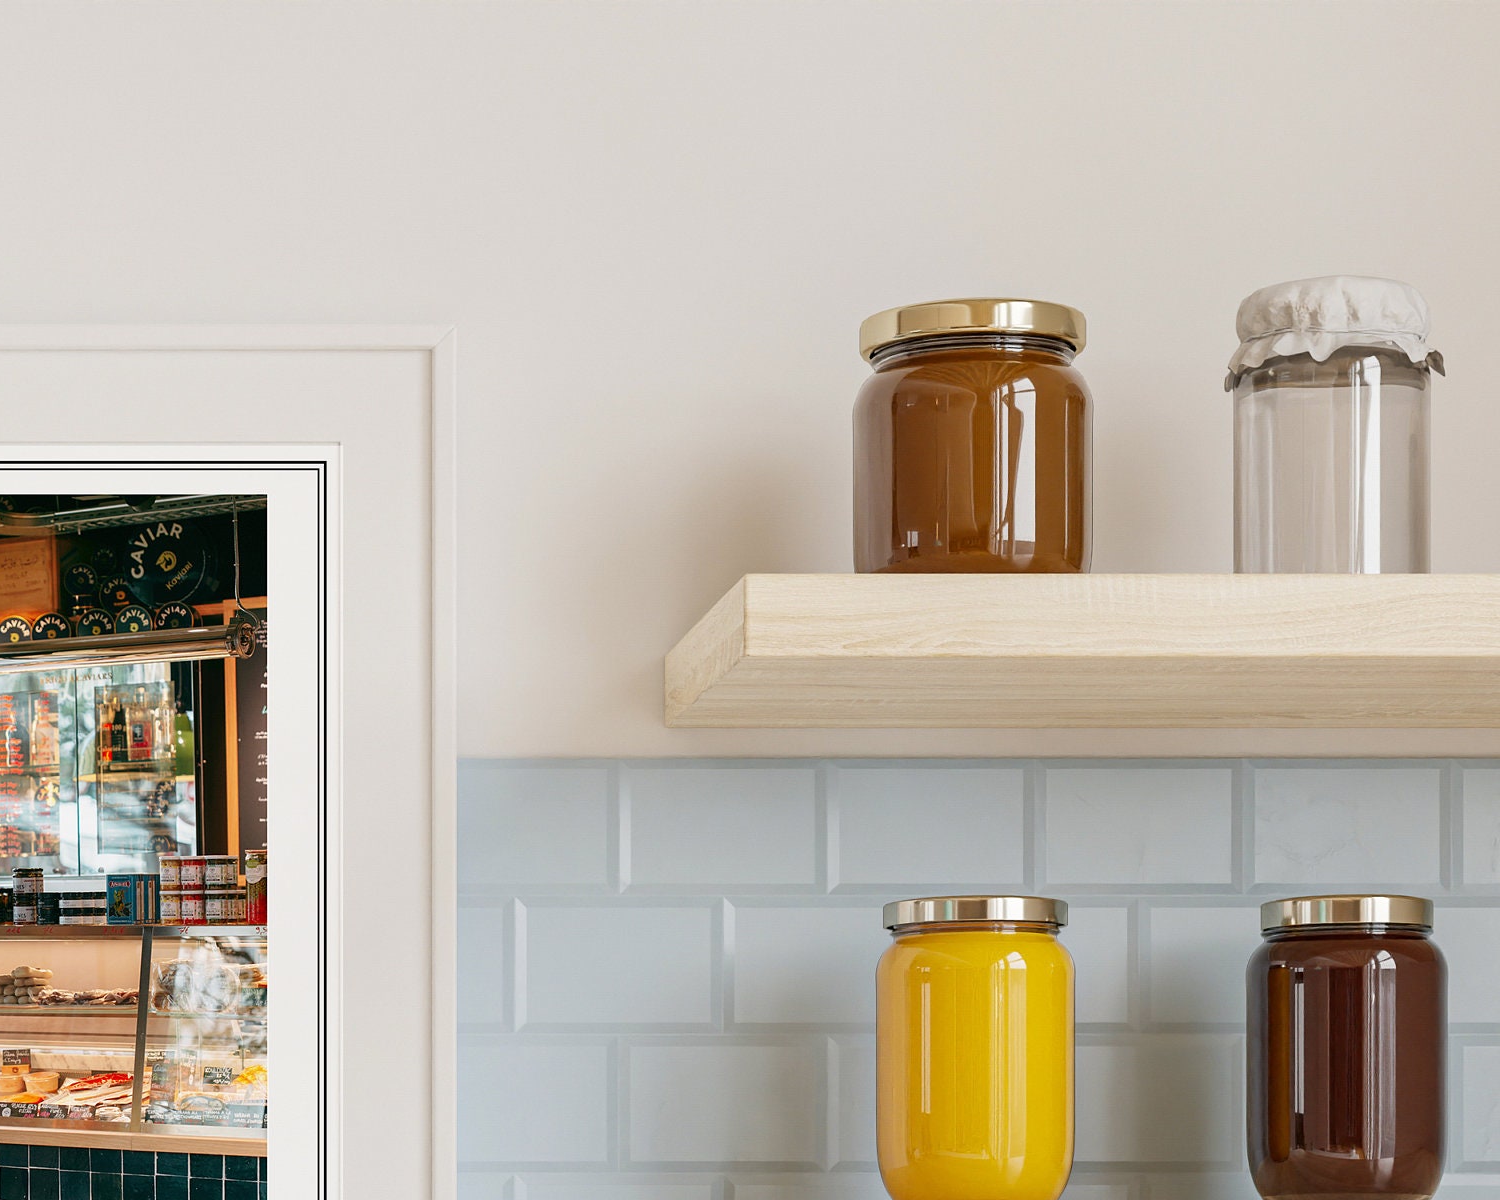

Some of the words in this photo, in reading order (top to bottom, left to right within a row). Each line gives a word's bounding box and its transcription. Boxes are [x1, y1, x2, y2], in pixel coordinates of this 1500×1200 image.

[131, 522, 183, 579] CAVIAR
[166, 561, 193, 590] Kaviari
[35, 616, 66, 634] CAVIAR
[83, 613, 112, 630] CAVIAR
[120, 609, 149, 626] CAVIAR
[158, 606, 187, 626] CAVIAR
[0, 619, 30, 638] CAVIAR
